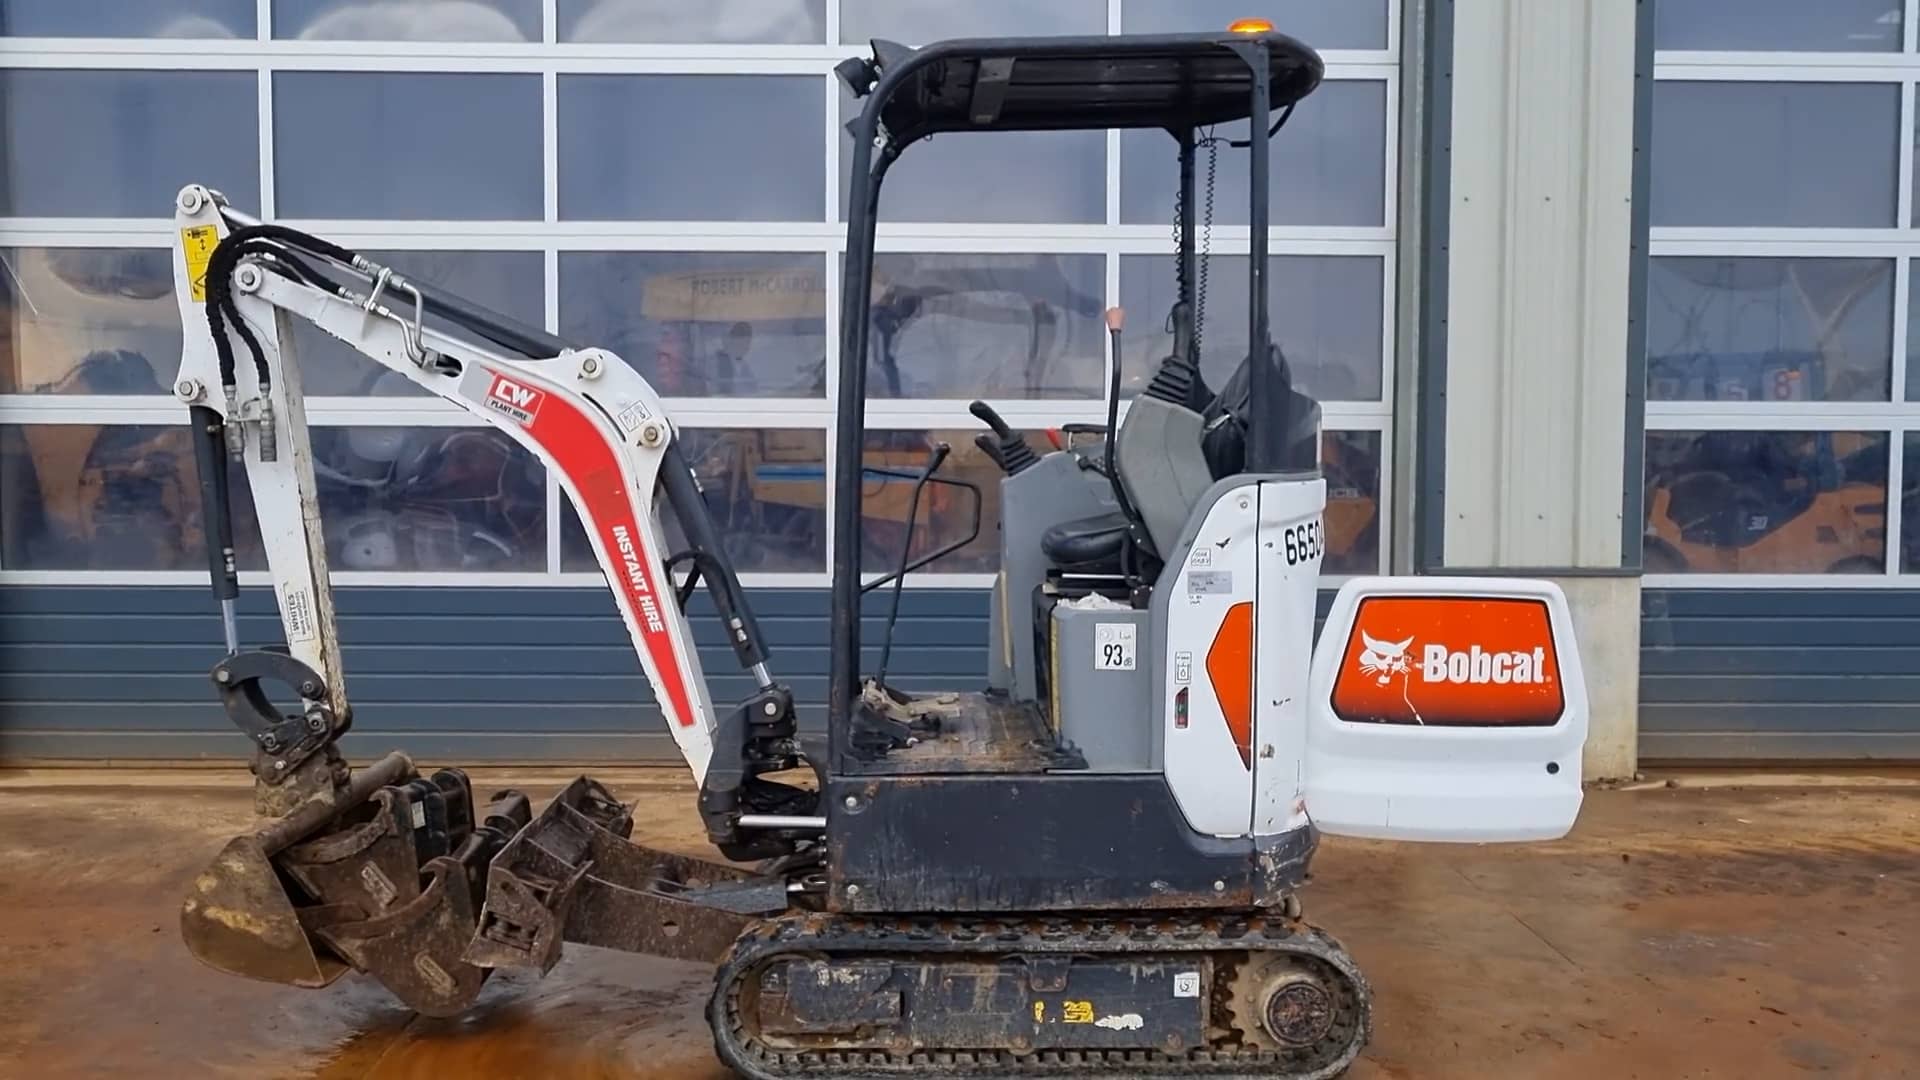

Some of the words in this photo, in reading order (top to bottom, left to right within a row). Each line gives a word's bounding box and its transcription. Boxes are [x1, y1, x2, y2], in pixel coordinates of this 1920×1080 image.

[690, 277, 745, 297] ROBERT
[495, 379, 536, 408] CW
[491, 400, 512, 414] PLANT
[512, 408, 528, 421] HIRE
[1284, 520, 1324, 566] 6650
[612, 525, 649, 593] INSTANT
[638, 595, 664, 633] HIRE
[1103, 643, 1123, 666] 93
[1423, 643, 1545, 684] Bobcat
